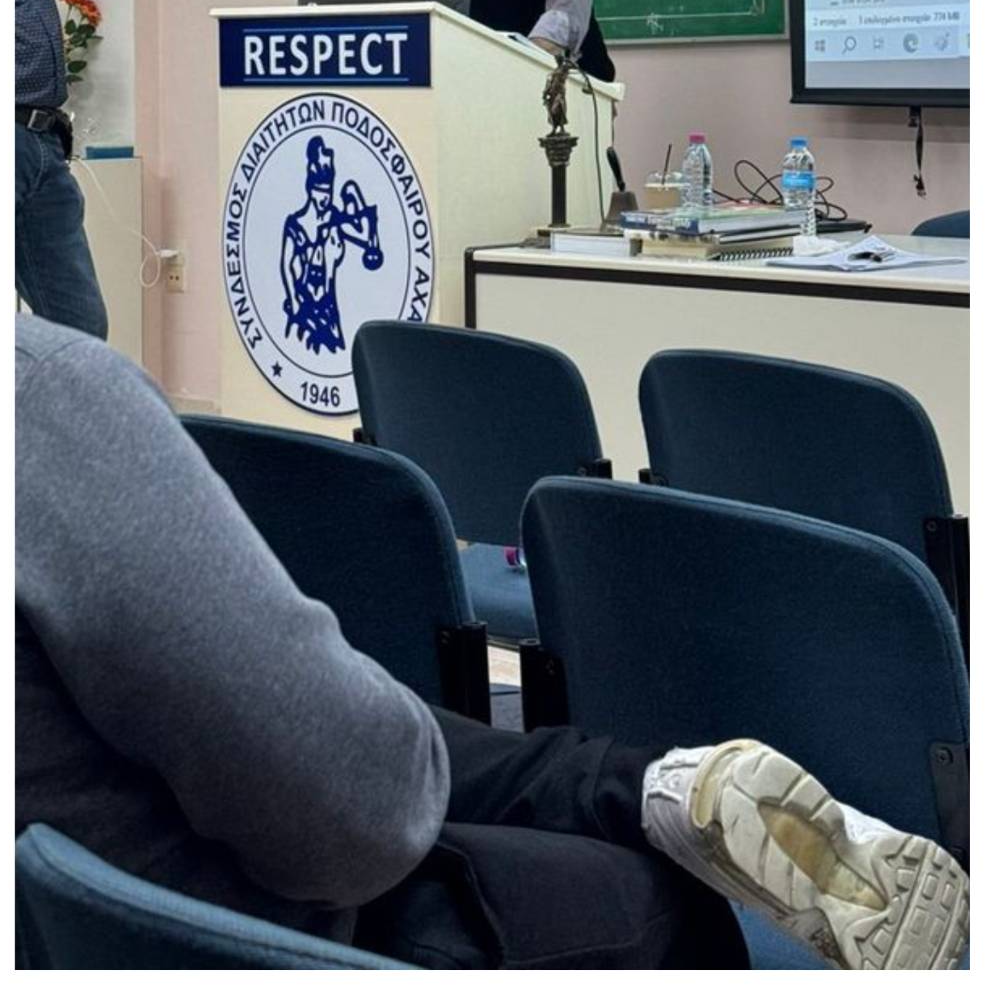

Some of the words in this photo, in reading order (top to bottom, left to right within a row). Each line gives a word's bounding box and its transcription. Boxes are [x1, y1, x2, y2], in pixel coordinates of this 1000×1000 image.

[244, 32, 408, 76] RESPECT
[240, 99, 325, 183] ΔΙΑΙΤΗΤΩΝ
[331, 101, 431, 260] ΠΟΔΟΣΦΑΙΡΟΥ
[226, 182, 263, 349] ΣΥΝΔΕΣΜΟΣ
[407, 265, 431, 323] ΑΧΑ
[300, 380, 340, 408] 1946
